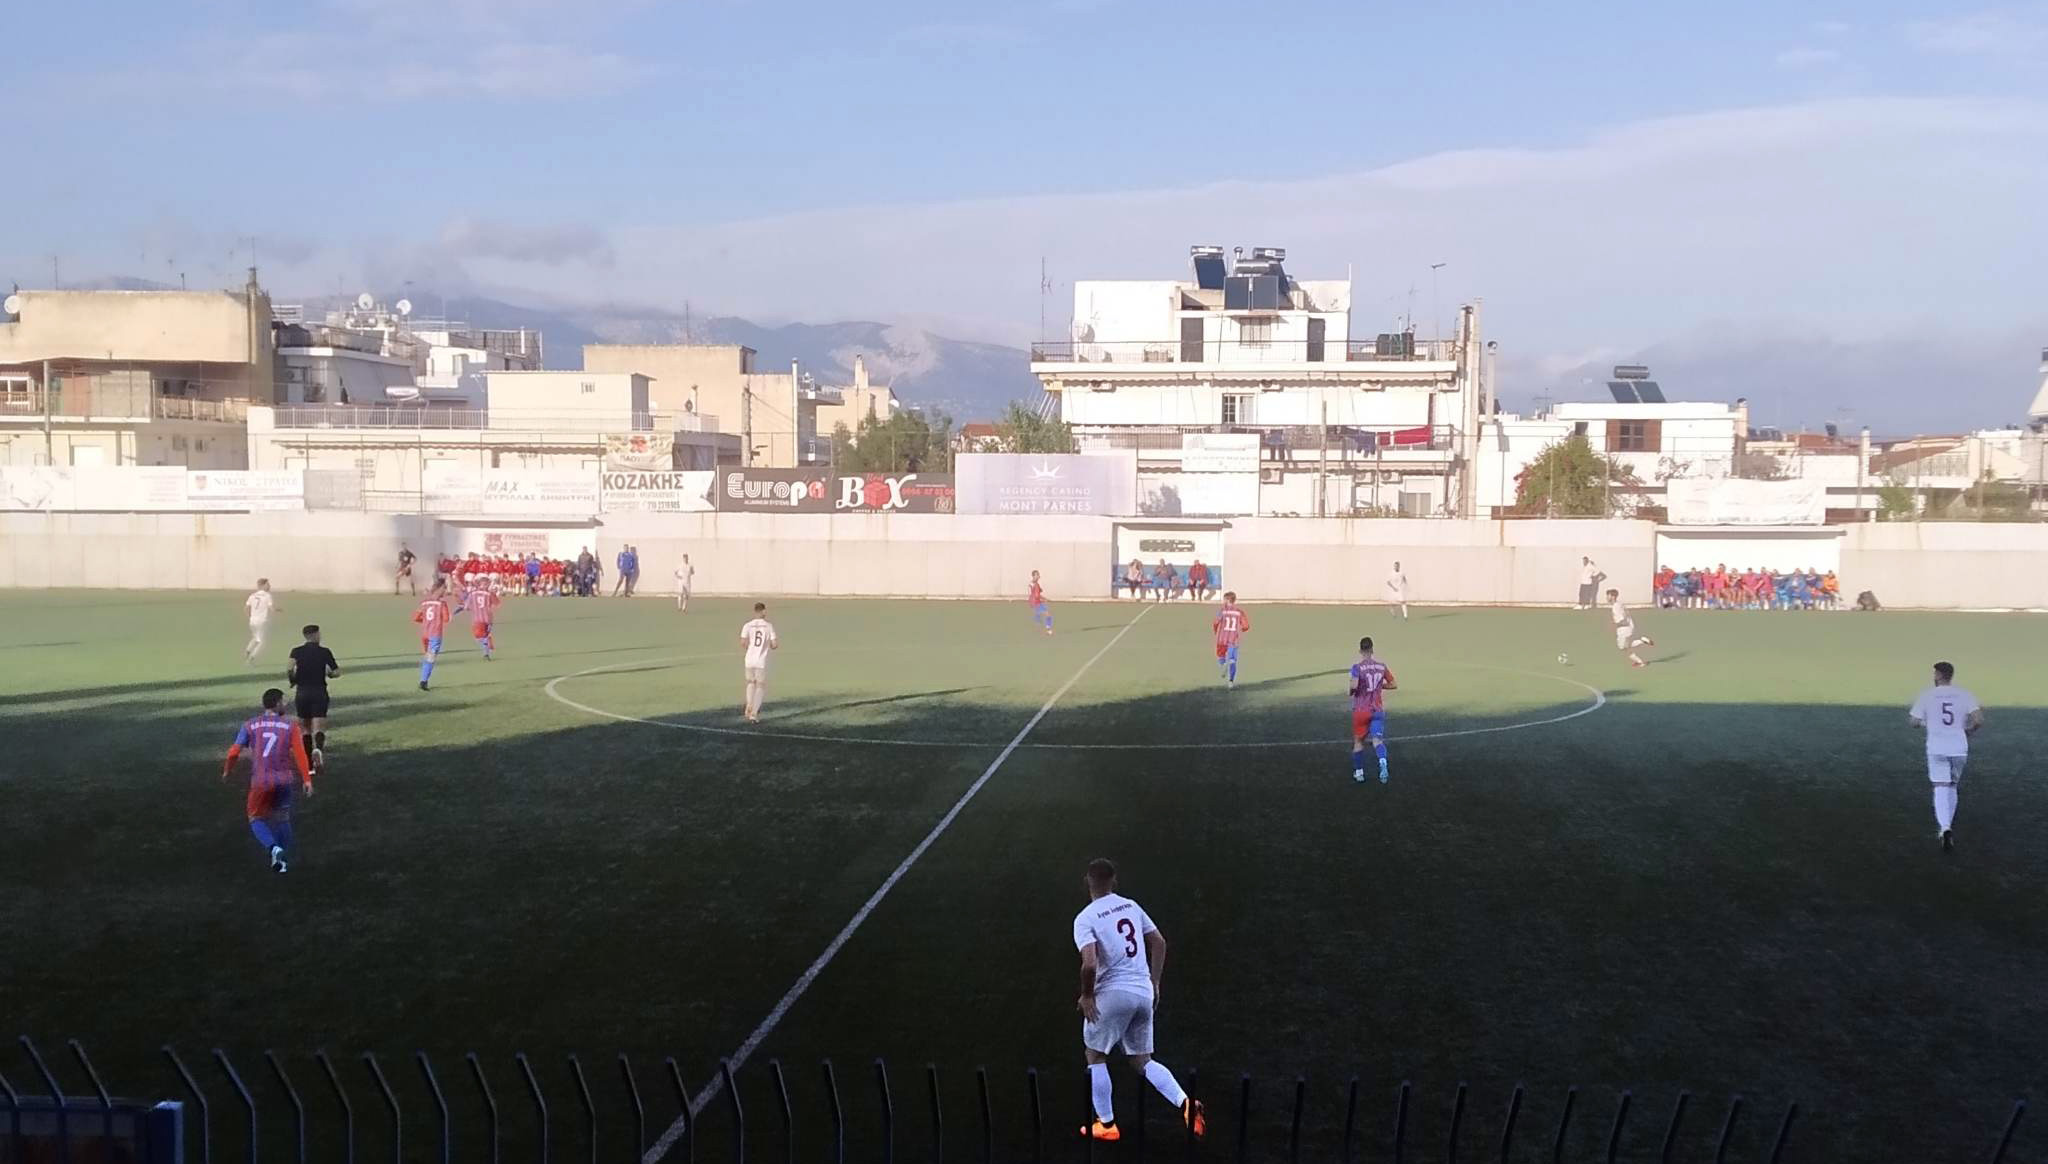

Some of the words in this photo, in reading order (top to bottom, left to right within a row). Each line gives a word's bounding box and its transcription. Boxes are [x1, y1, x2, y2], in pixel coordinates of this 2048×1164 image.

[602, 474, 684, 490] ΚΟΖΑΚΗΣ
[1000, 487, 1047, 496] REGENCY
[1051, 487, 1091, 496] CASINO
[1000, 500, 1036, 512] MONT
[1043, 500, 1092, 512] PARNES
[476, 596, 485, 608] 9
[426, 606, 435, 620] 6
[1223, 616, 1237, 631] 11
[754, 630, 763, 647] 6
[1942, 702, 1954, 726] 5
[262, 732, 277, 758] 7
[1117, 918, 1138, 958] 3
